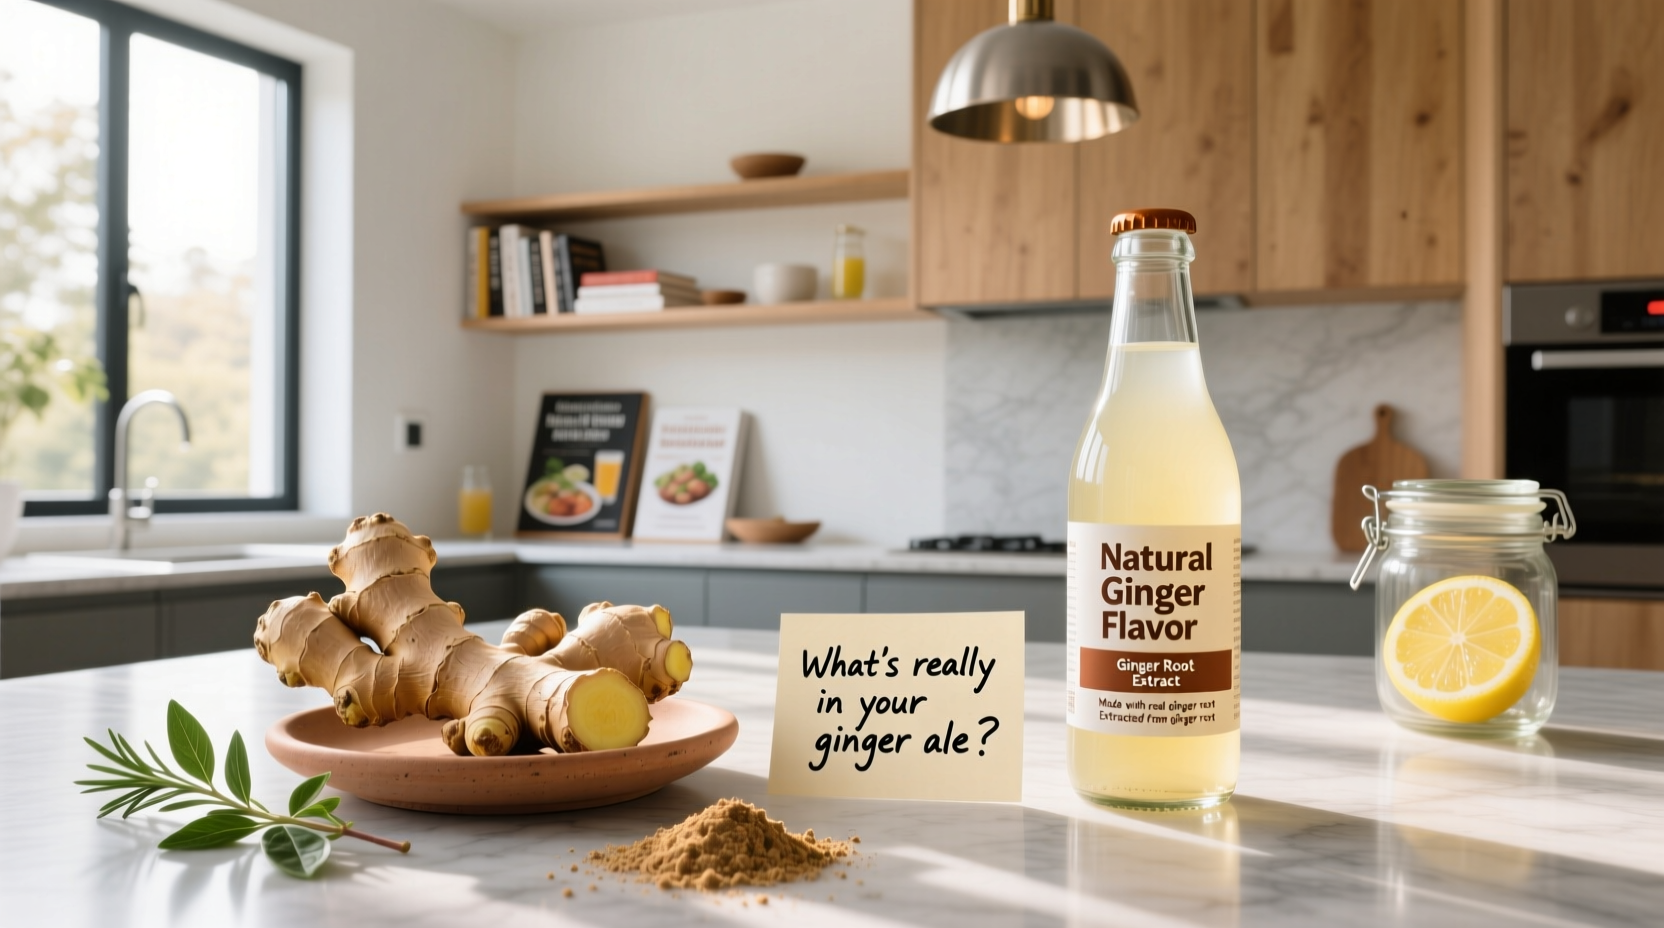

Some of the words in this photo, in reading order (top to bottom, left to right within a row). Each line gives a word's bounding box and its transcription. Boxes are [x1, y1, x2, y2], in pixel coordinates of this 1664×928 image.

[1101, 542, 1213, 572] Natural
[1101, 576, 1206, 615] Ginger
[1102, 610, 1198, 641] Flavor
[802, 645, 899, 678] What's
[912, 645, 996, 694] really
[1116, 658, 1160, 675] Ginger
[1163, 659, 1195, 672] Root
[1132, 674, 1181, 687] Extract
[816, 688, 843, 714] in
[854, 695, 928, 732] your
[1099, 710, 1145, 724] Extracted
[1148, 701, 1166, 711] real
[808, 725, 912, 772] ginger
